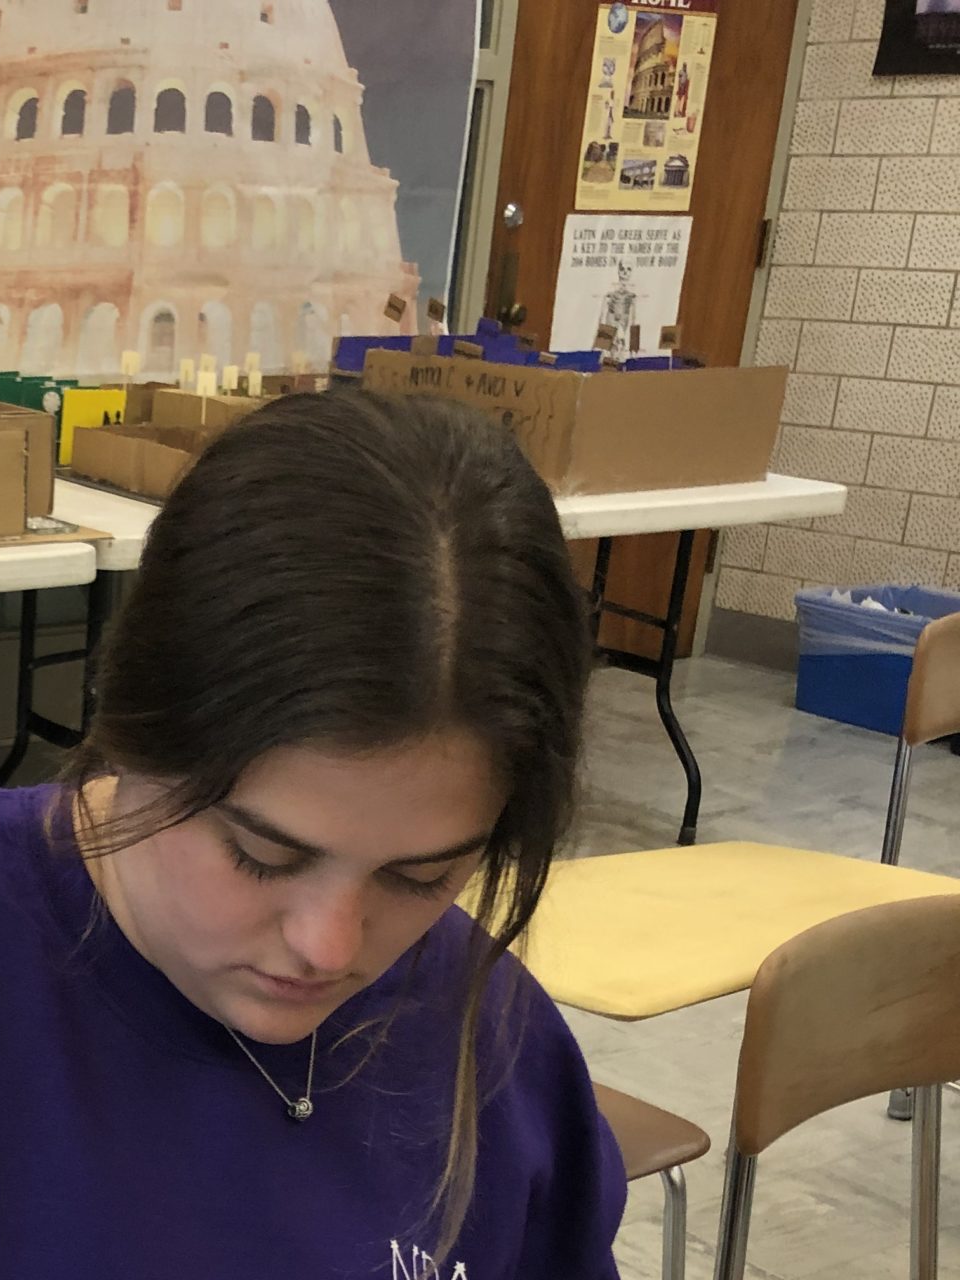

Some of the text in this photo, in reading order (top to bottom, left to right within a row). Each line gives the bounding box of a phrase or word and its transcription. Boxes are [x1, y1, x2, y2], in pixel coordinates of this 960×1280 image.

[573, 229, 596, 240] LATIN
[601, 229, 615, 240] AND
[618, 229, 642, 240] GREEK
[672, 229, 682, 240] AS
[581, 243, 596, 254] KEY
[611, 243, 625, 254] THE
